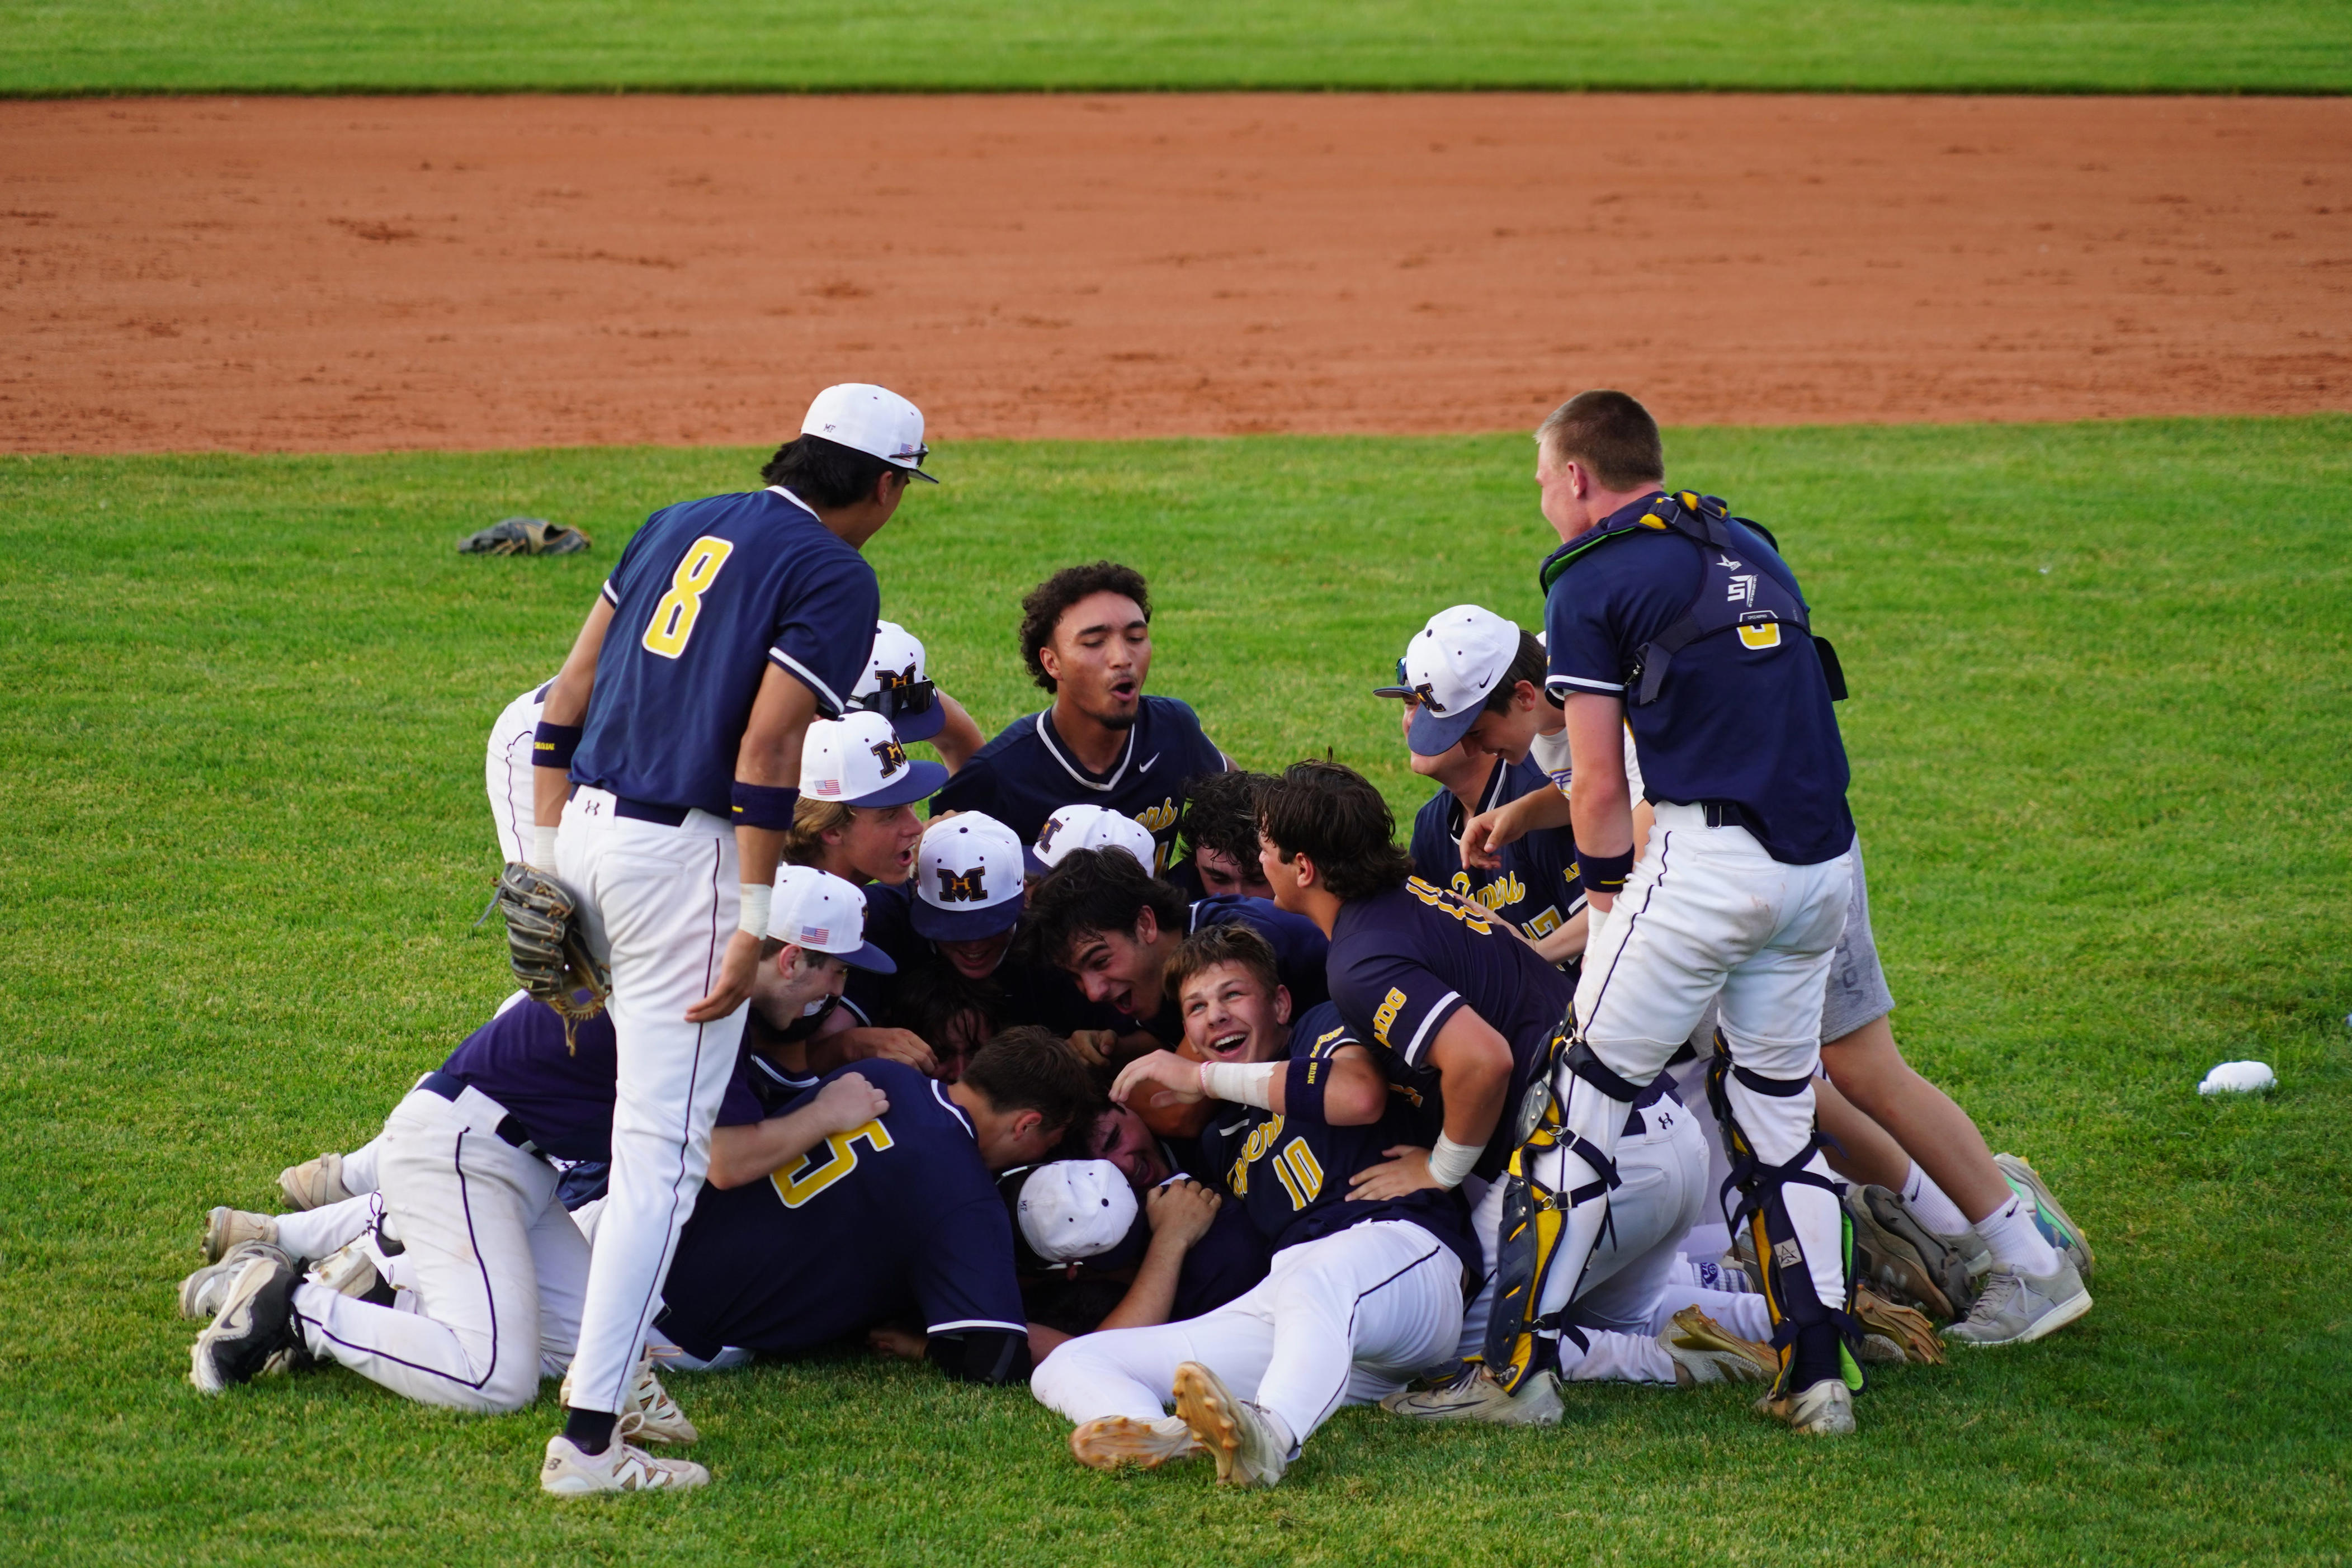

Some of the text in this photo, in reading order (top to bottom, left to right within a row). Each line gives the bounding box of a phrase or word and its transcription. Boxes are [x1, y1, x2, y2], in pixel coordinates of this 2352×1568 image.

[642, 535, 734, 659] 8
[769, 1118, 895, 1208] 5
[1272, 1136, 1324, 1211] 10
